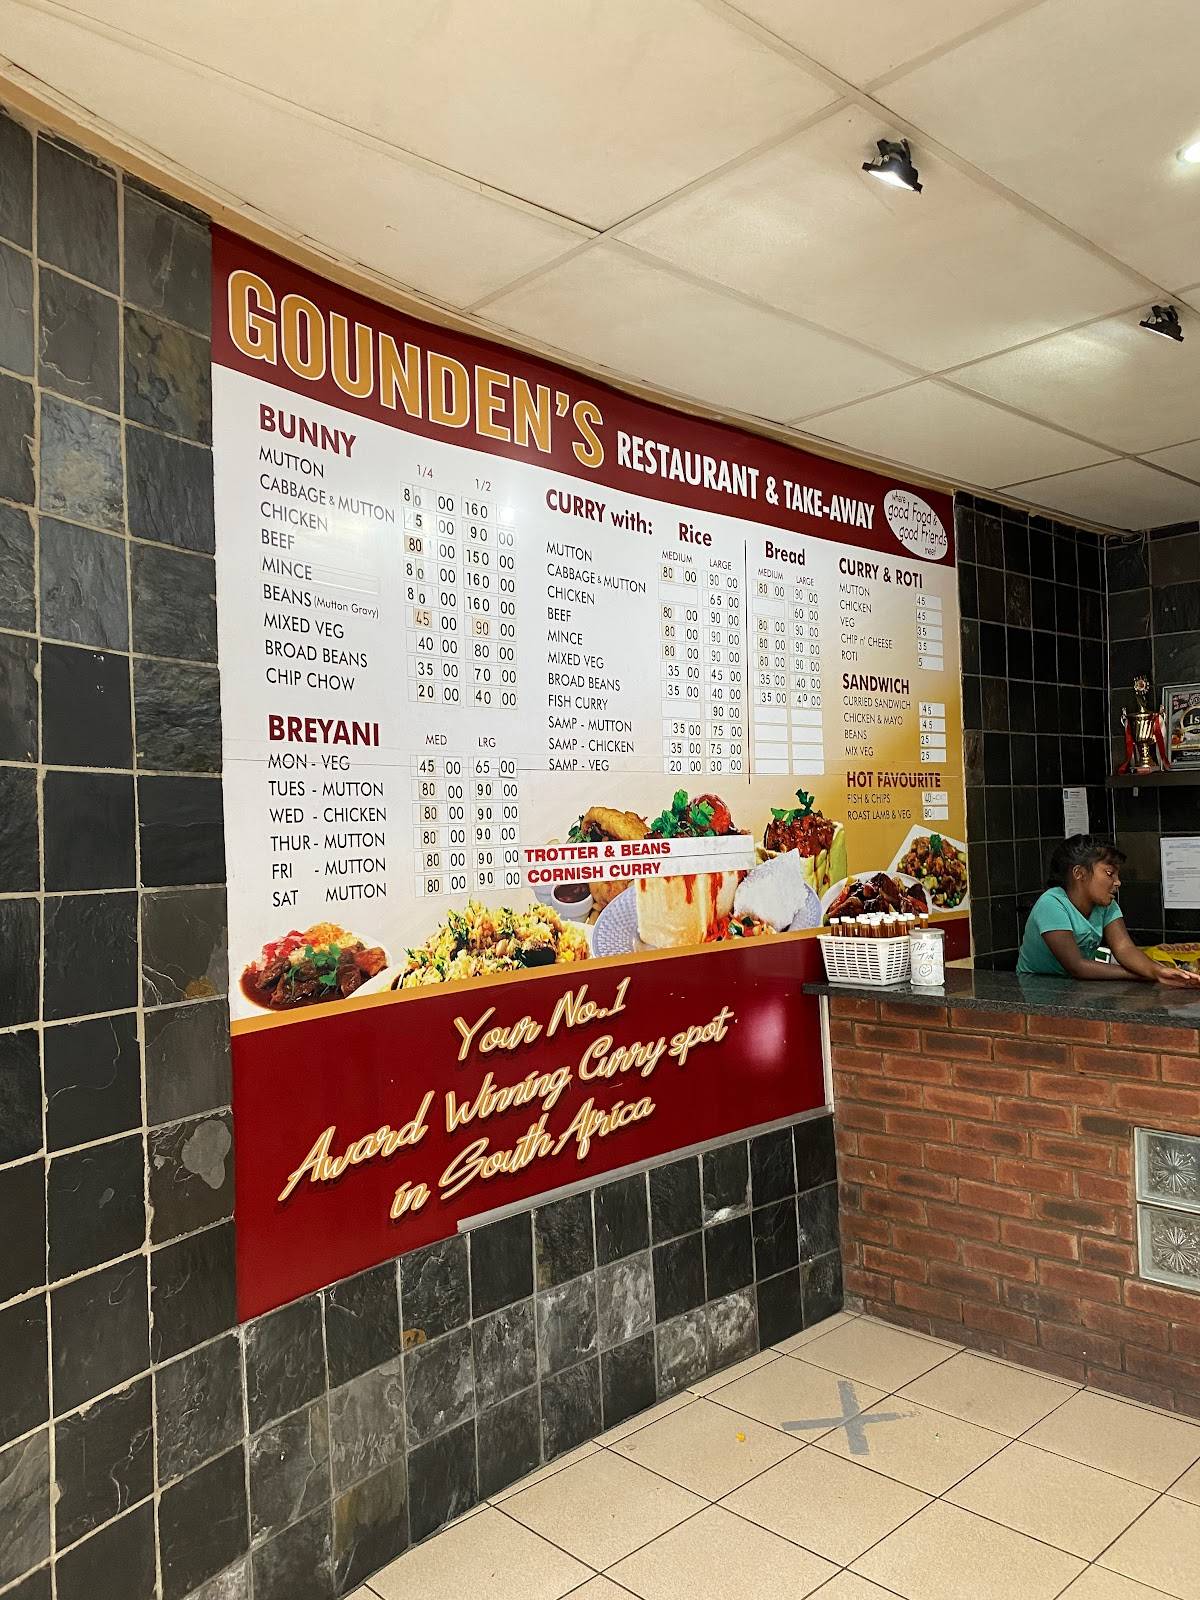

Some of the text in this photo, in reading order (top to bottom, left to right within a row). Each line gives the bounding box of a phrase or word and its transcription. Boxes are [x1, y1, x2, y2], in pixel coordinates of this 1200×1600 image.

[227, 269, 604, 468] GOUNDEN'S
[260, 403, 356, 458] BUNNY
[259, 445, 324, 478] MUTTON
[417, 464, 433, 478] 1/4
[475, 478, 491, 491] 1/2
[617, 430, 874, 530] RESTAURANT & TAKE-AWAY
[260, 474, 326, 505] CABBAGE
[338, 496, 395, 523] MUTTON
[260, 501, 328, 532] CHICKEN
[546, 489, 652, 535] CURRY with:
[261, 528, 295, 550] BEEF
[678, 522, 712, 546] Rice
[546, 541, 592, 562] MUTTON
[661, 550, 693, 563] MEDIUM
[765, 541, 806, 566] Bread
[262, 556, 312, 580] MINCE
[709, 558, 732, 570] LARGE
[547, 563, 595, 584] CABBAGE
[603, 576, 646, 593] MUTTON
[757, 568, 784, 580] MEDIUM
[796, 576, 814, 587] LARGE
[839, 558, 922, 589] CURRY & ROTI
[547, 585, 595, 605] CHICKEN
[839, 583, 870, 597] MUTTON
[263, 584, 379, 619] BEANS (Mutton Gravy)
[840, 599, 872, 613] CHICKEN
[416, 611, 457, 631] 45 00
[547, 607, 572, 622] BEEF
[840, 616, 855, 628] VEG
[264, 612, 344, 639] MIXED VEG
[476, 621, 515, 637] 90 00
[418, 637, 457, 653] 40 00
[547, 629, 583, 645] MINCE
[841, 633, 858, 645] CHIP
[868, 637, 892, 649] CHEESE
[265, 640, 367, 668] BROAD BEANS
[474, 644, 514, 660] 80 00
[547, 651, 604, 669] MIXED VEG
[842, 650, 857, 661] ROTI
[418, 662, 458, 677] 35 00
[475, 668, 516, 683] 70 00
[668, 665, 699, 679] 35 00
[711, 669, 741, 682] 45 00
[266, 668, 355, 691] CHIP CHOW
[548, 672, 621, 691] BROAD BEANS
[842, 673, 910, 694] SANDWICH
[418, 685, 459, 701] 20 00
[475, 690, 516, 706] 40 00
[548, 694, 608, 710] FISH CURRY
[843, 696, 911, 710] CURRIED SANDWICH
[548, 716, 632, 732] SAMP MUTTON
[843, 712, 876, 724] CHICKEN
[883, 715, 903, 726] MAYO
[268, 714, 379, 746] BREYANI
[844, 729, 867, 739] BEANS
[425, 734, 447, 746] MED
[478, 737, 496, 748] LRG
[548, 738, 634, 752] SAMP CHICKEN
[845, 747, 874, 757] MIX VEG
[267, 753, 350, 771] MON VEG
[419, 759, 461, 775] 45 00
[475, 760, 515, 774] 65 00
[548, 759, 609, 771] SAMP VEG
[670, 760, 701, 772] 20 00
[847, 771, 941, 788] HOT FAVOURITE
[268, 781, 383, 797] TUES MUTTON
[422, 783, 462, 799] 80 00
[477, 783, 517, 796] 90 00
[847, 793, 863, 803] FISH
[871, 794, 891, 803] CHIPS
[269, 807, 386, 823] WED CHICKEN
[847, 810, 870, 821] ROAST
[872, 810, 890, 820] LAMB
[898, 809, 911, 819] VEG
[270, 832, 385, 851] THUR MUTTON
[524, 842, 671, 862] TROTTER & BEANS
[272, 857, 386, 879] FRI MUTTON
[527, 862, 661, 883] CORNISH CURRY
[272, 883, 387, 907] SAT MUTTON
[453, 1007, 542, 1061] Your
[277, 1006, 735, 1201] Award Winning Curry spot
[389, 1095, 656, 1220] in South Africa
